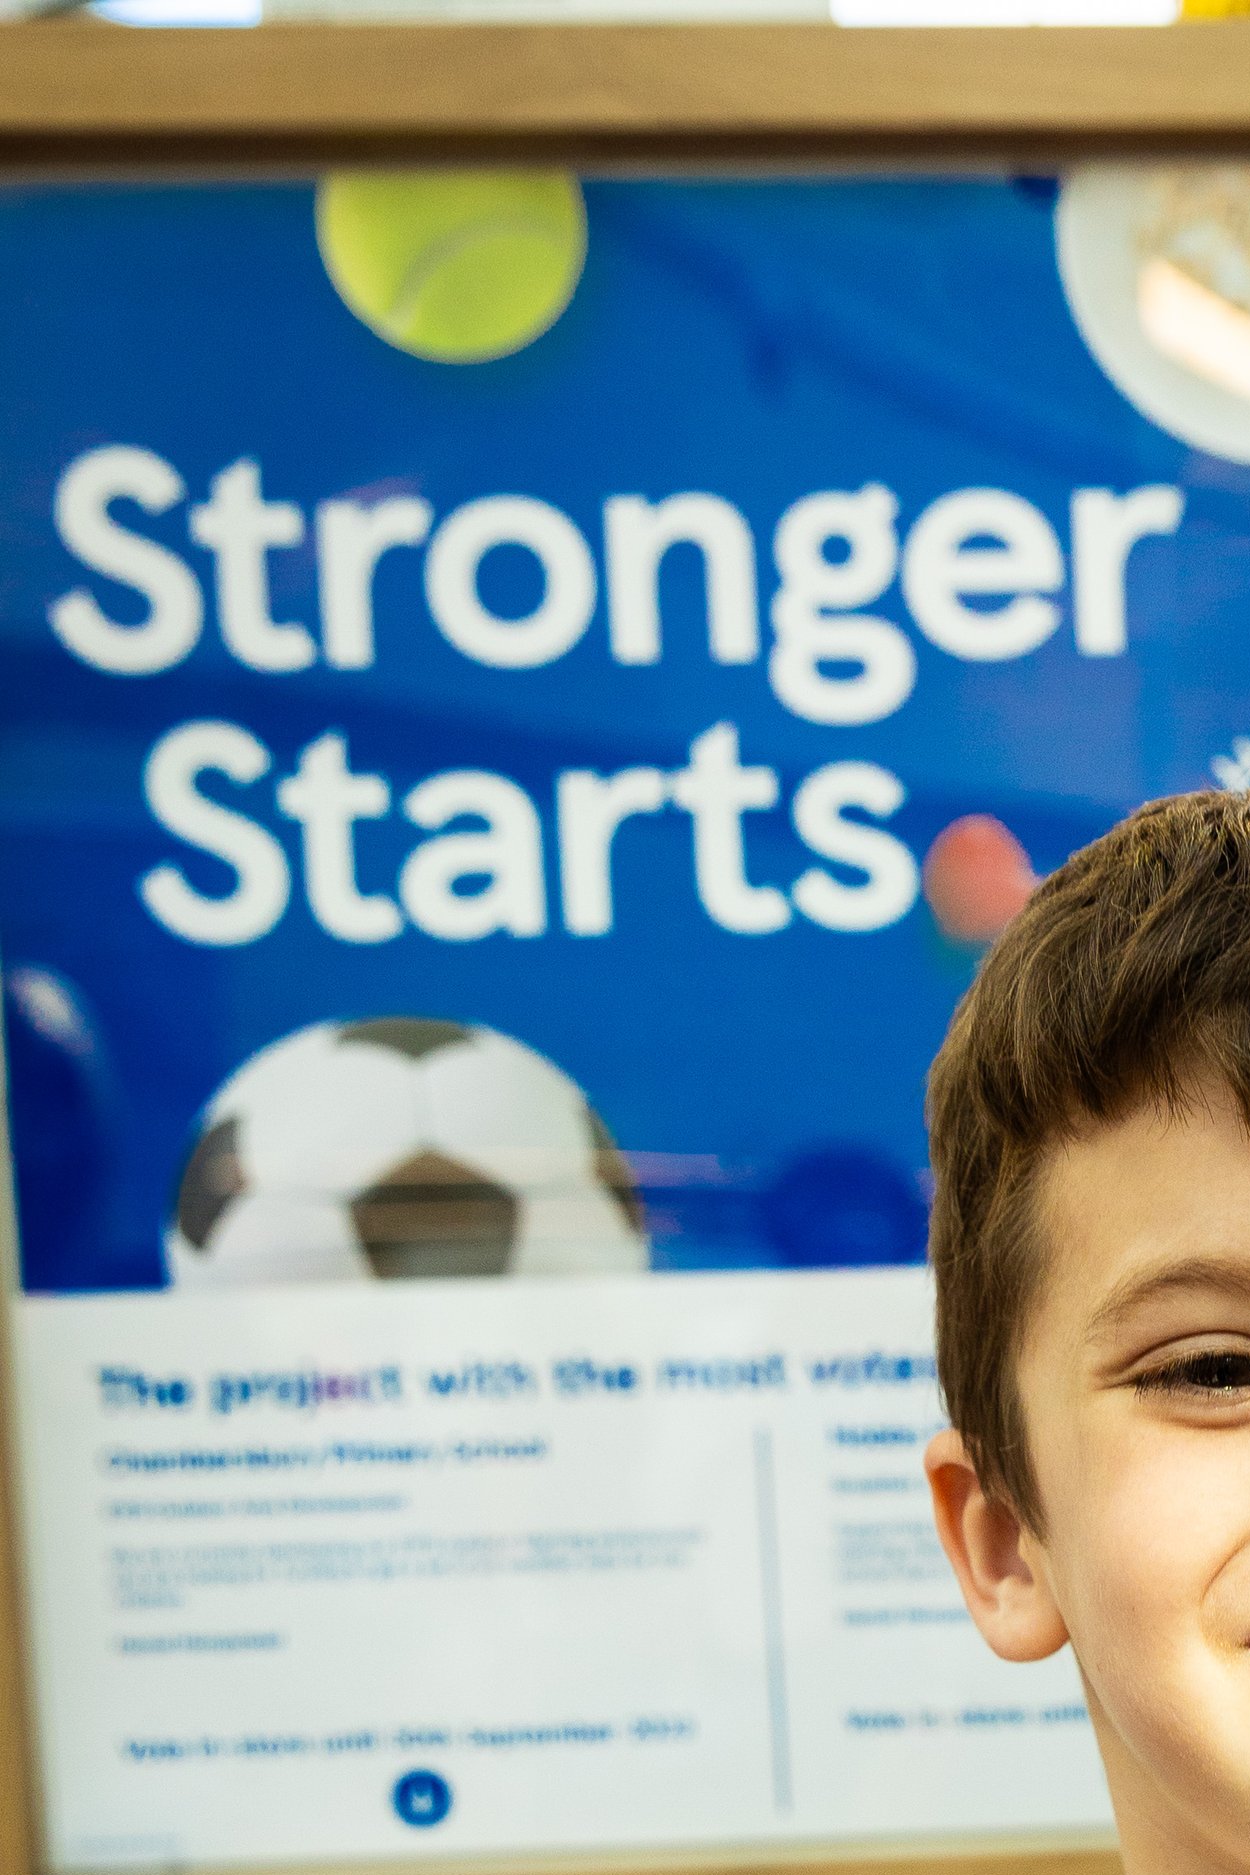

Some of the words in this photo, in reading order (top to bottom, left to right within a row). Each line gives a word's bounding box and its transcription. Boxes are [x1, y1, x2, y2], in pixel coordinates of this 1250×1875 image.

[51, 444, 1185, 727] Stronger
[140, 719, 921, 946] Starts
[96, 1365, 192, 1406] The
[213, 1362, 401, 1414] project
